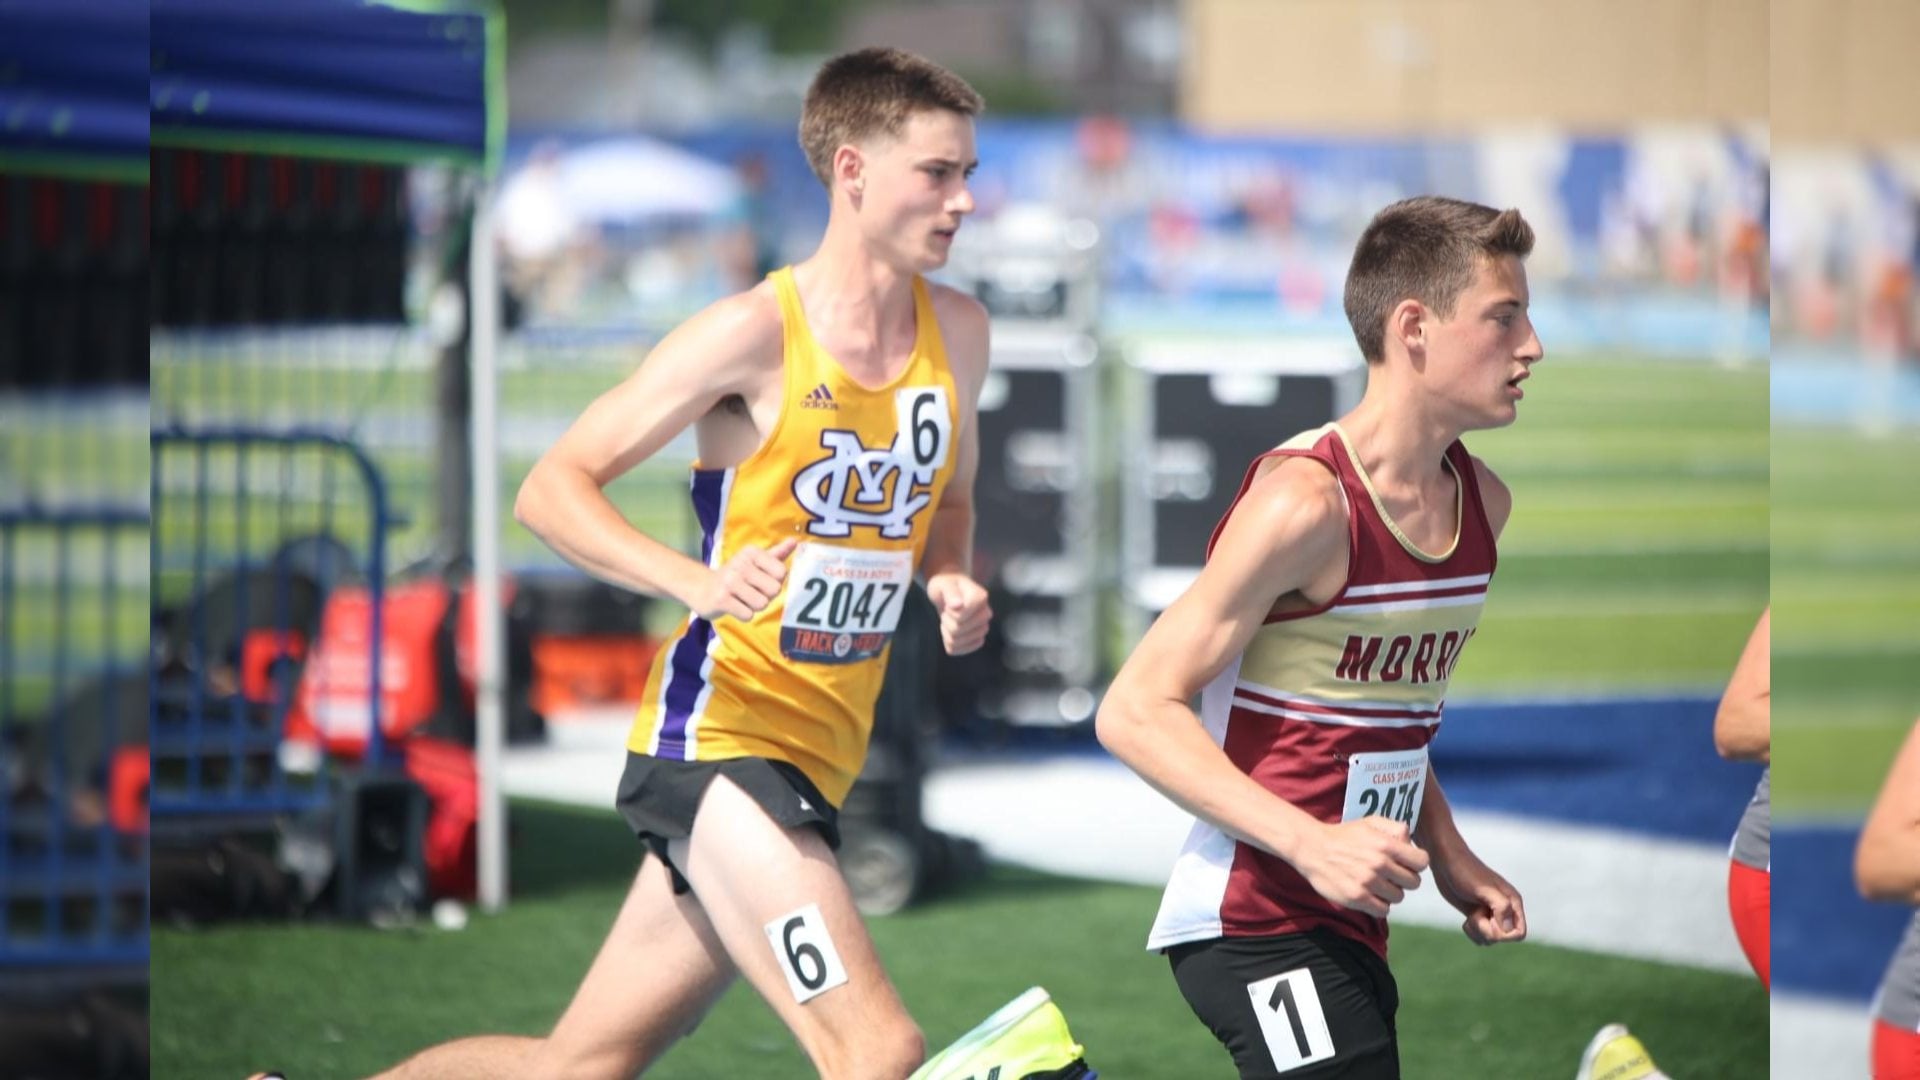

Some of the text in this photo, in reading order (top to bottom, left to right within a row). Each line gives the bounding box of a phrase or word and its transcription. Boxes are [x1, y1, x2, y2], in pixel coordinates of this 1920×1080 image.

[800, 399, 839, 410] adidas
[911, 392, 940, 466] 6
[796, 577, 900, 630] 2047
[794, 629, 834, 654] TRACK
[1372, 772, 1395, 785] CLASS
[1359, 780, 1420, 830] 2474
[783, 915, 828, 991] 6
[1268, 978, 1313, 1060] 1
